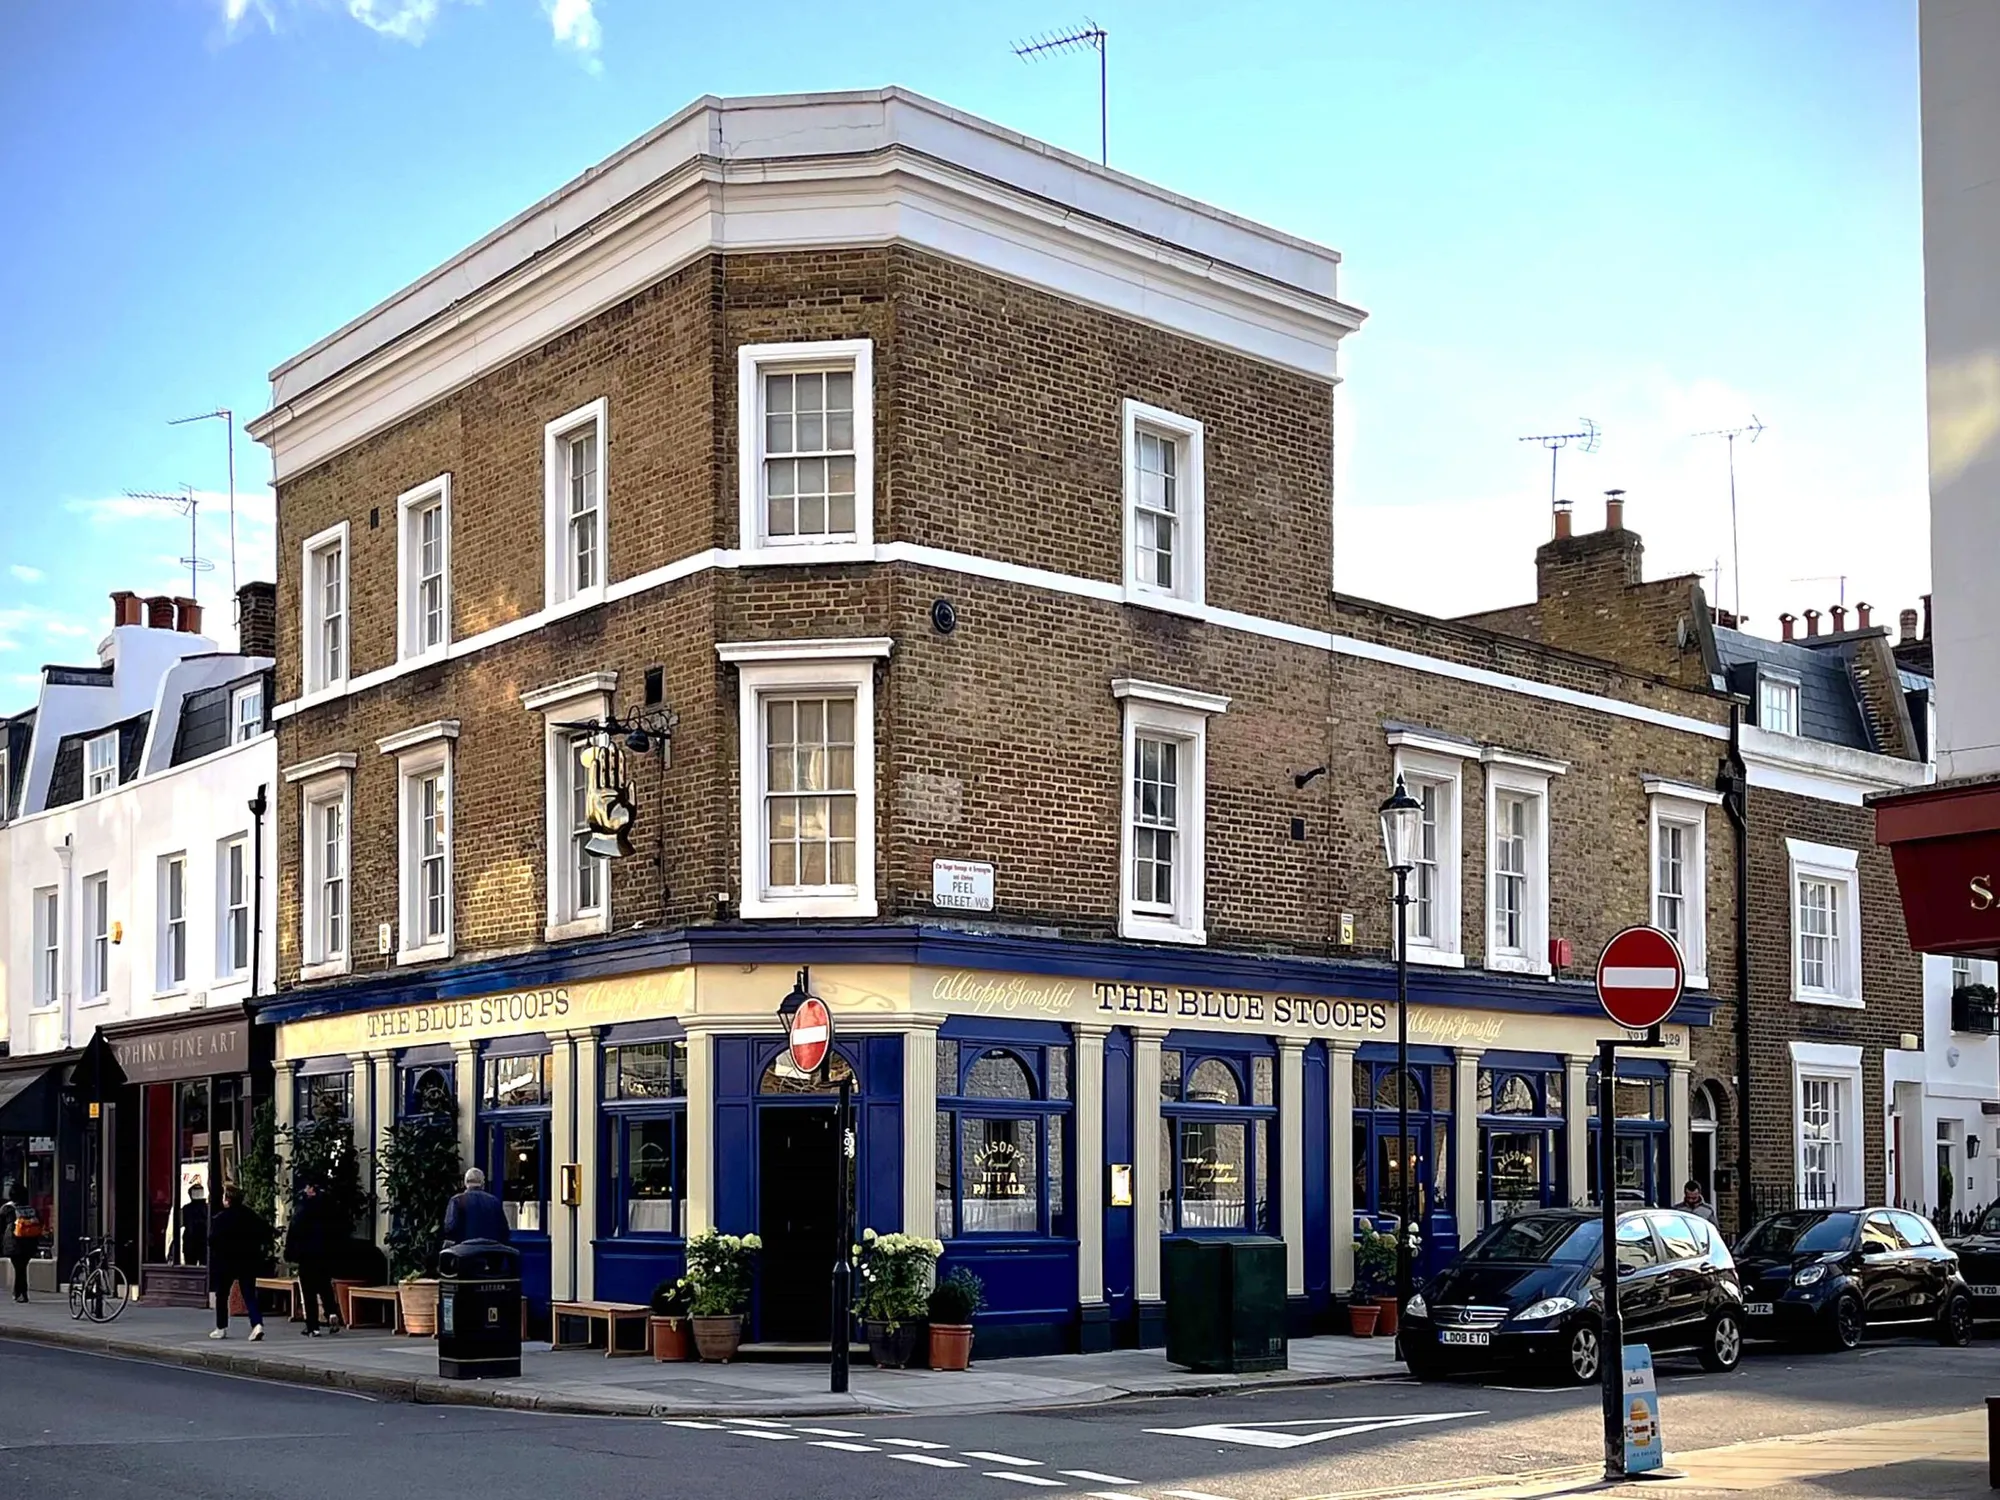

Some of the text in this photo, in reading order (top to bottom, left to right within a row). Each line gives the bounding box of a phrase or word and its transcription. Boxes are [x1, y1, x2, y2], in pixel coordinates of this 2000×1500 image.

[952, 881, 975, 894] PEEL
[1970, 874, 2000, 910] S
[367, 988, 569, 1038] THE BLUE STOOPS
[1092, 981, 1387, 1032] THE BLUE STOOPS
[117, 1040, 165, 1066] SPHINX
[172, 1035, 204, 1059] FINE
[210, 1030, 237, 1054] ART
